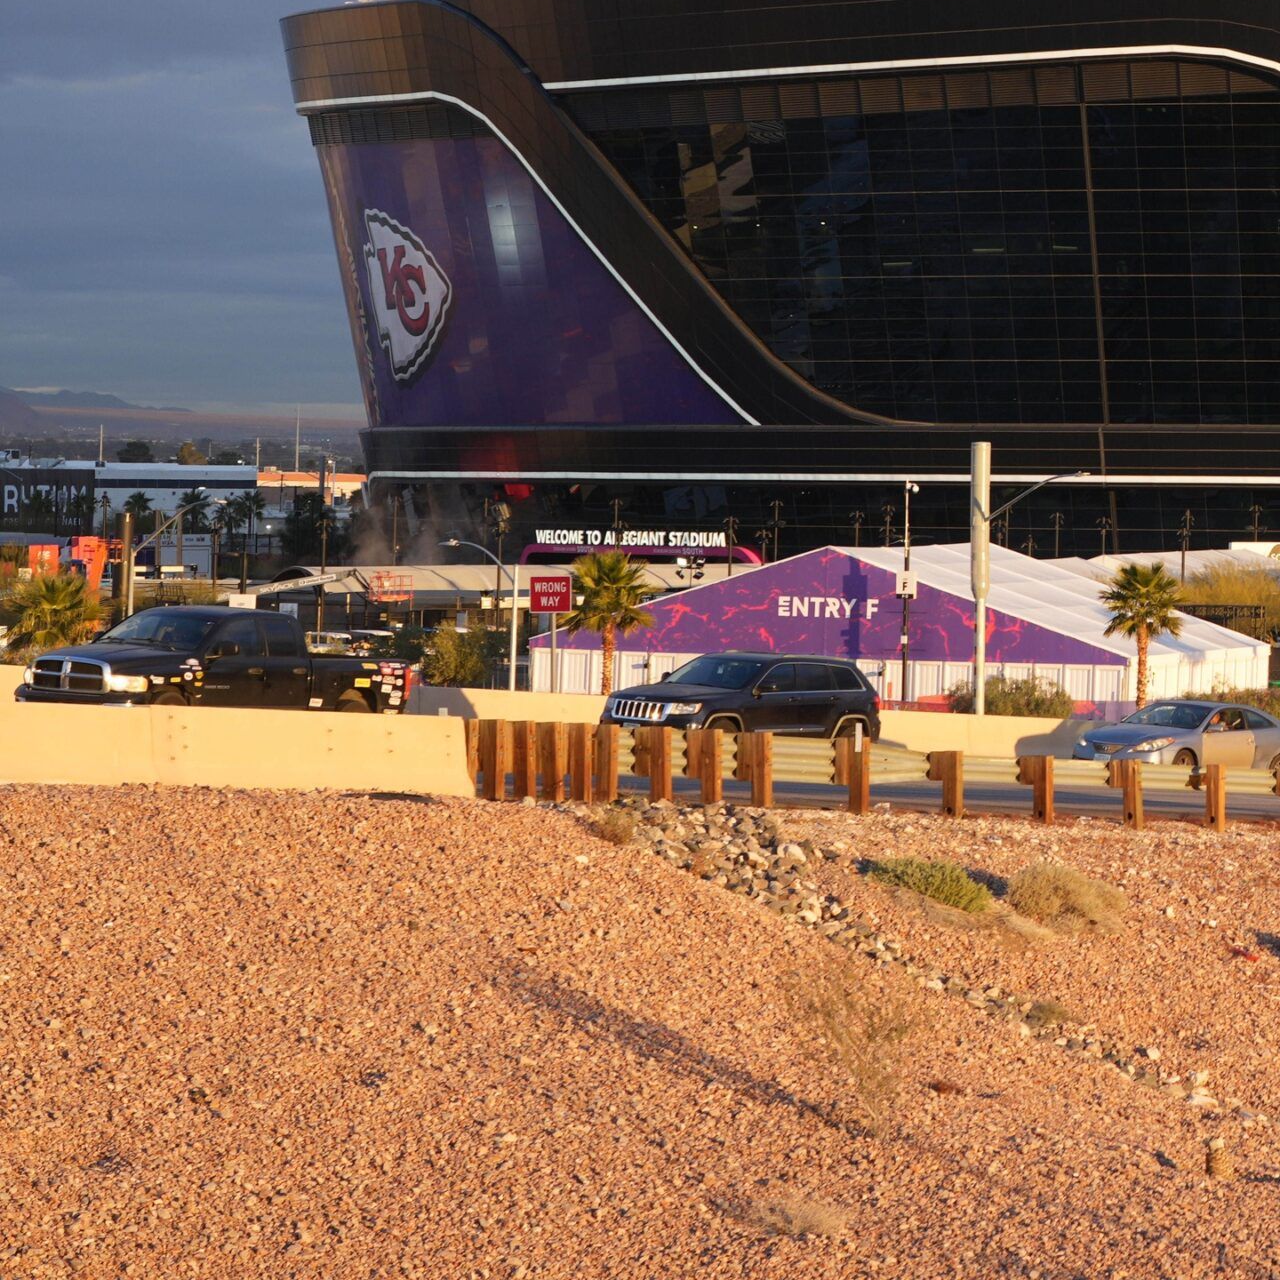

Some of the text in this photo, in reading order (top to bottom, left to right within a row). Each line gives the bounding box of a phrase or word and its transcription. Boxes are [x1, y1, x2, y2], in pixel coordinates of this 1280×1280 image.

[376, 245, 431, 337] KC
[535, 529, 584, 544] WELCOME
[586, 530, 602, 545] TO
[668, 532, 727, 548] STADIUM
[260, 582, 294, 593] SKYJACK
[534, 581, 567, 593] WRONG
[903, 581, 909, 592] F
[540, 596, 561, 607] WAY
[778, 595, 880, 620] ENTRY F
